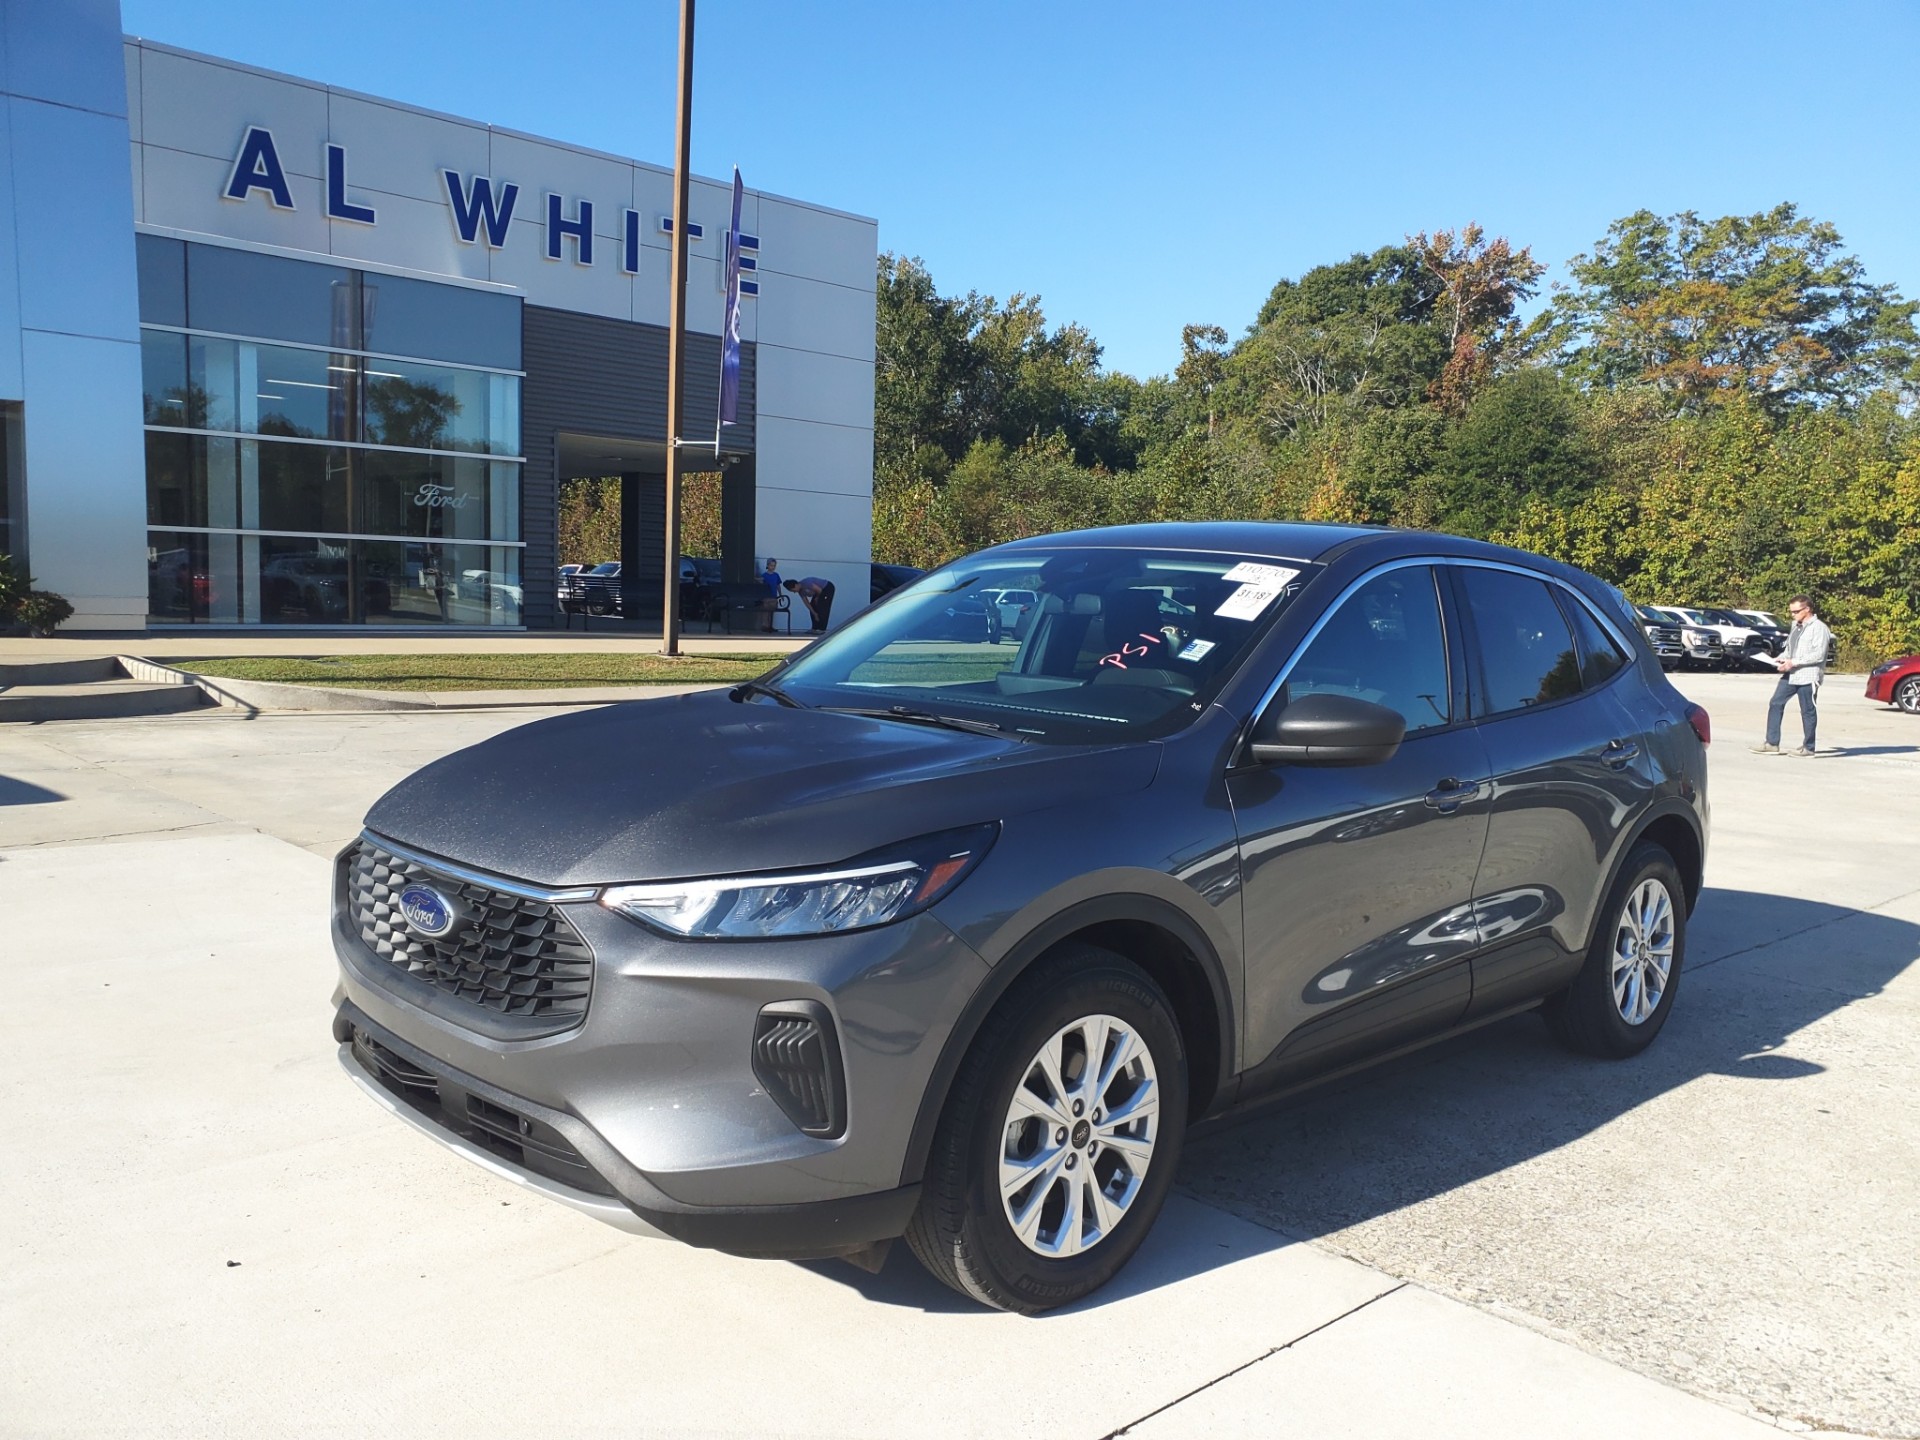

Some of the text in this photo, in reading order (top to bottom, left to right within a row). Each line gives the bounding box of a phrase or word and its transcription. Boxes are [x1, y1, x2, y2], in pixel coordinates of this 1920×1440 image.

[223, 125, 376, 225] AL
[413, 483, 468, 509] Ford
[406, 893, 437, 927] Ford
[1098, 979, 1155, 1008] MICHELIN
[1017, 1277, 1085, 1298] MICHELIN
